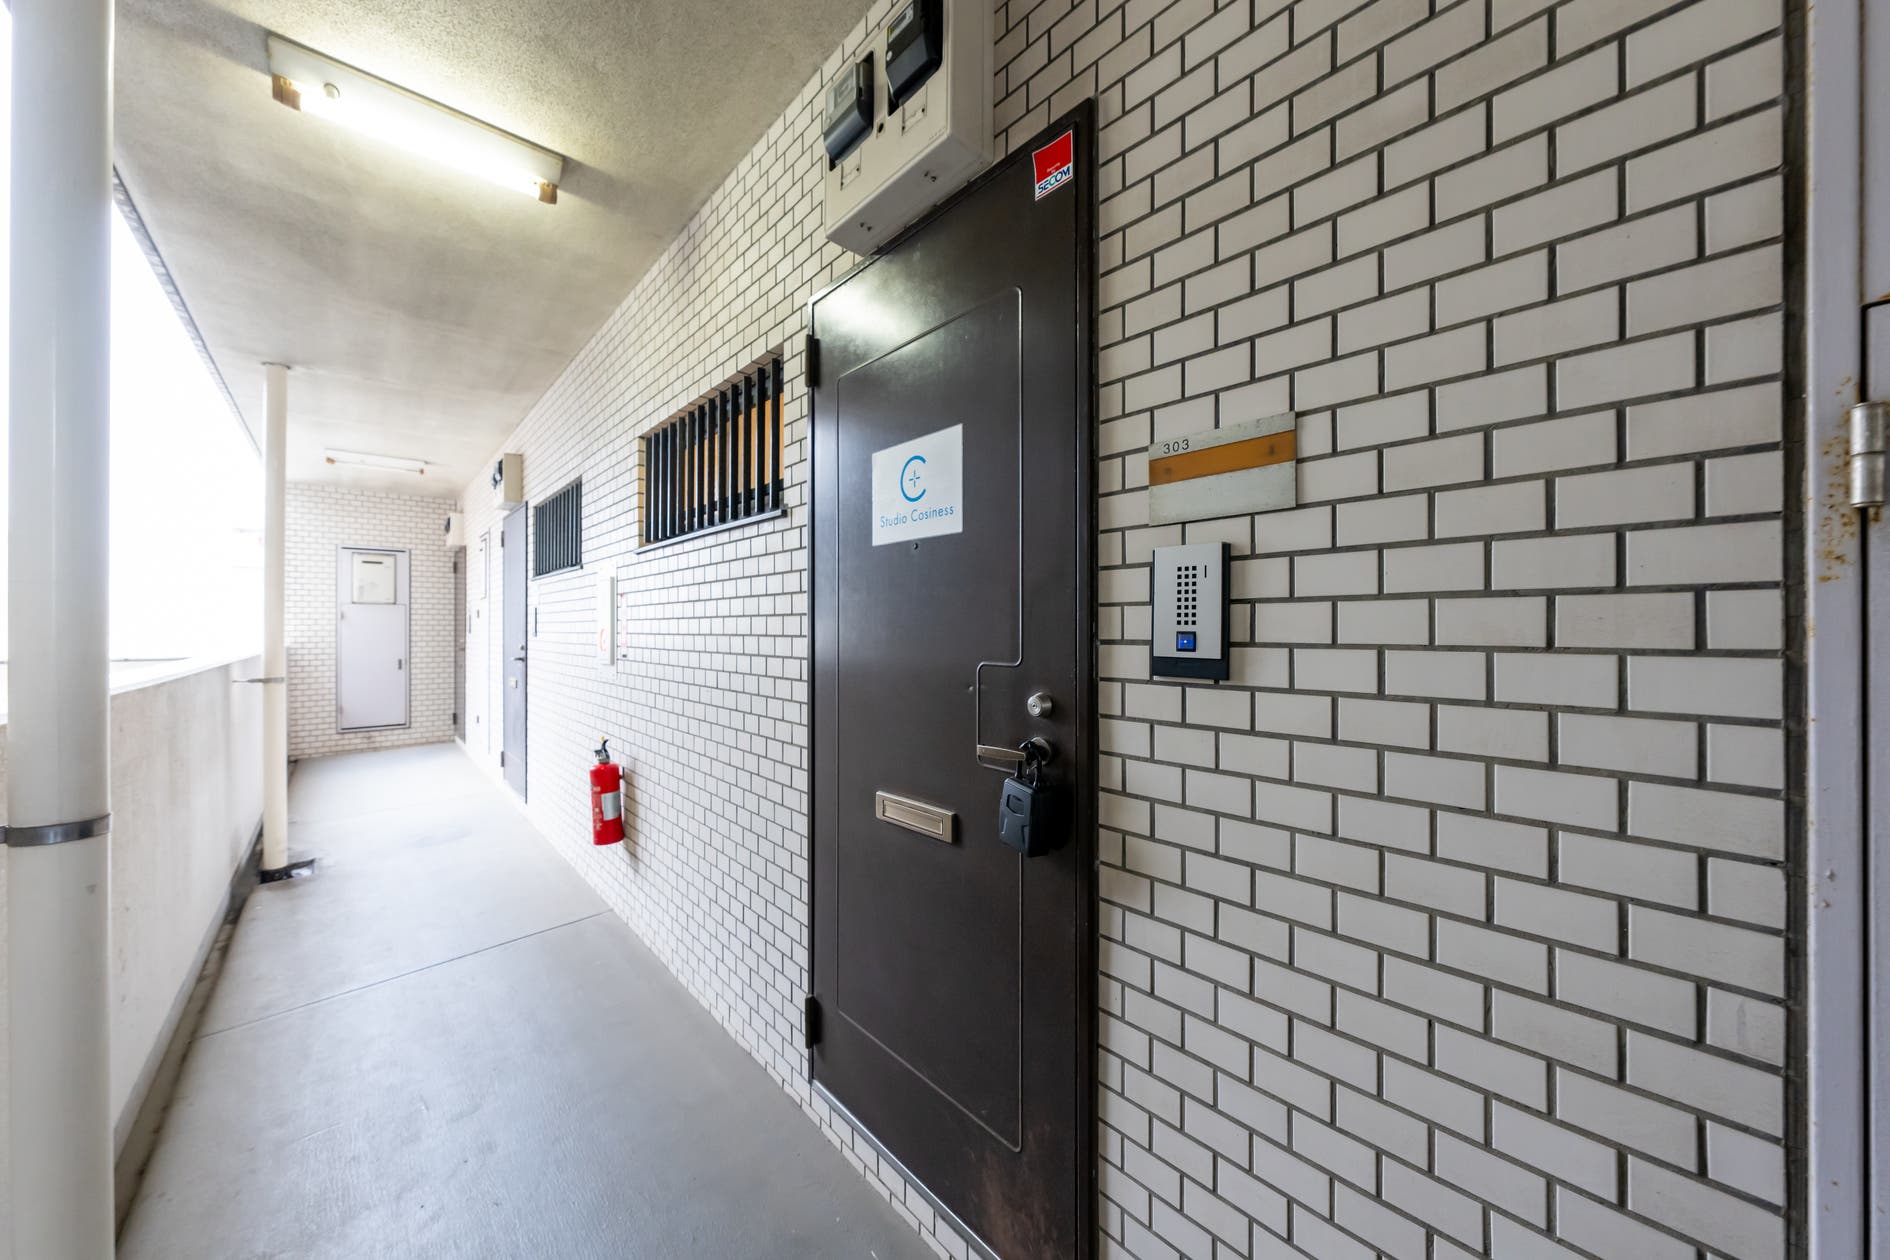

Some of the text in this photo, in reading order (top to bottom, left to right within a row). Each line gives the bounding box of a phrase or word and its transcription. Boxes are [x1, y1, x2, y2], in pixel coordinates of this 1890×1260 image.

[1038, 165, 1071, 194] SECOM
[1163, 438, 1189, 454] 303
[880, 505, 955, 528] Studio Cosiness
